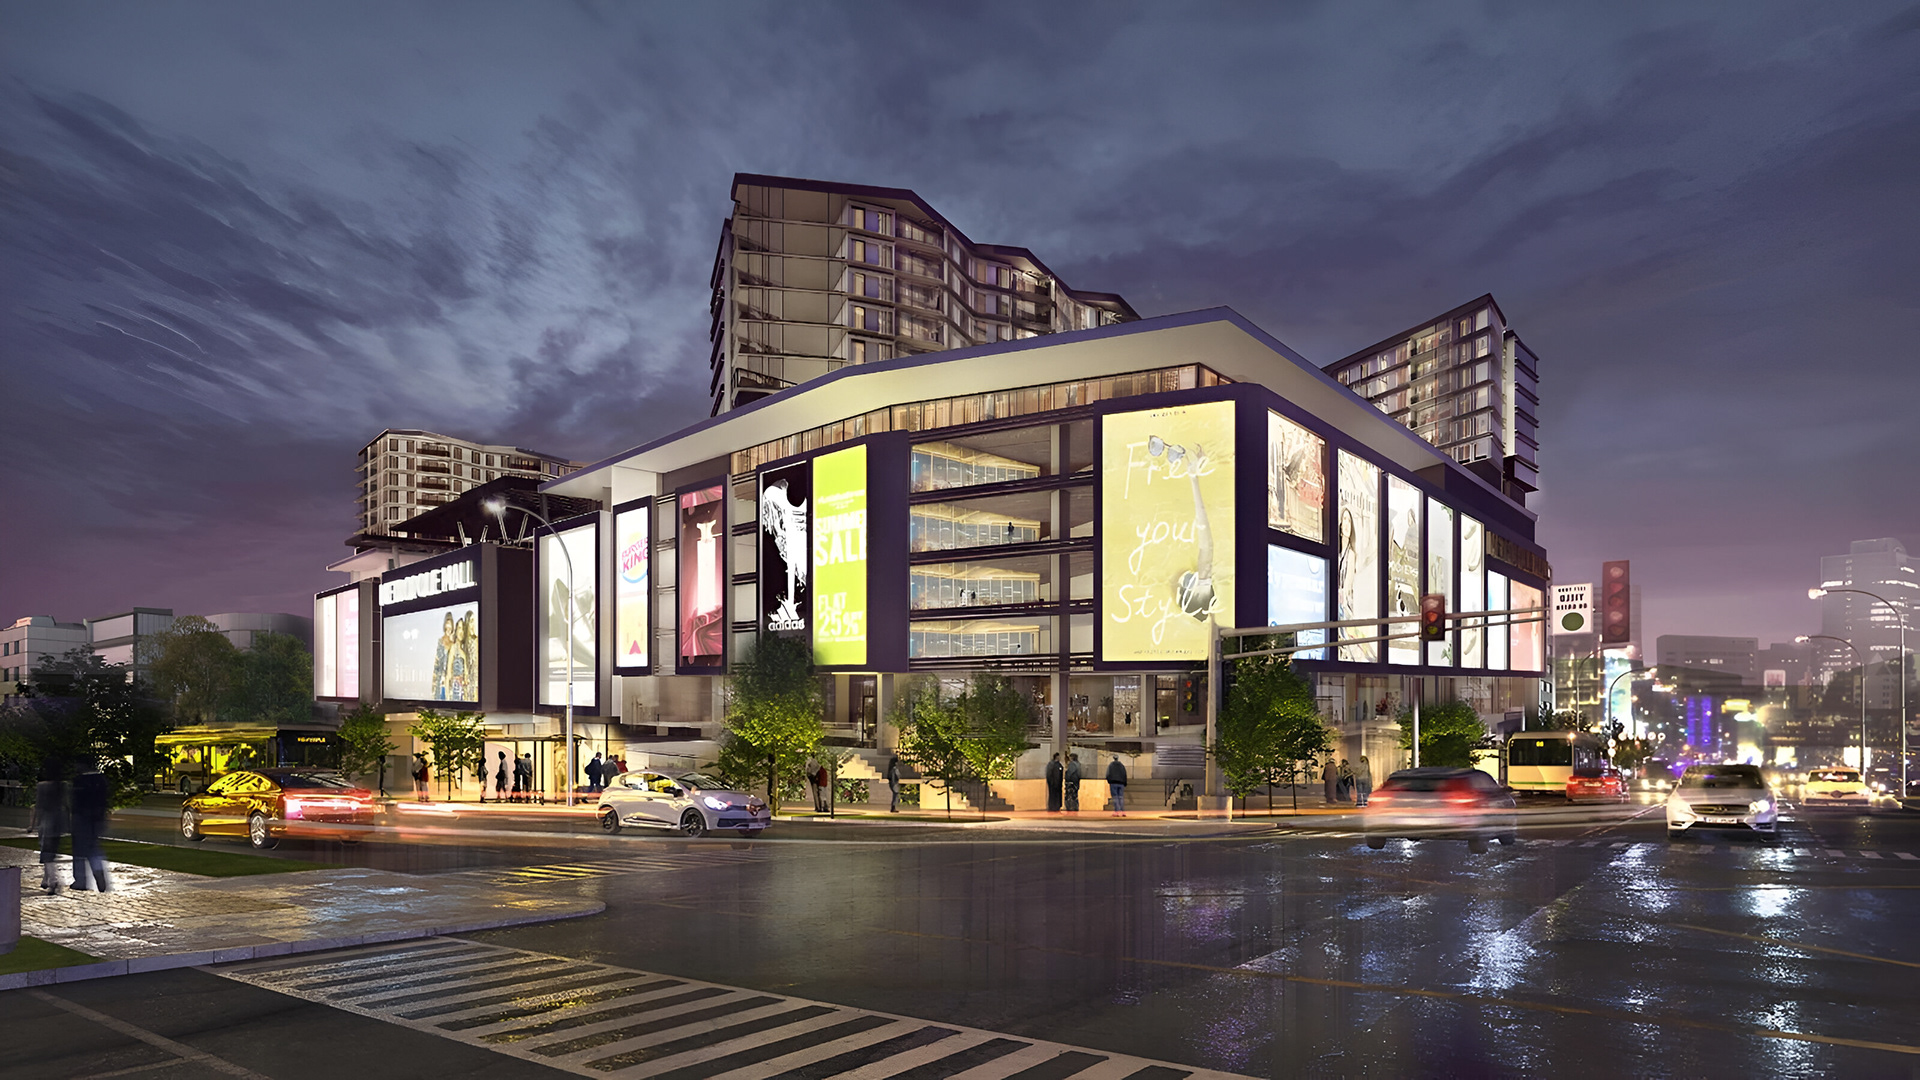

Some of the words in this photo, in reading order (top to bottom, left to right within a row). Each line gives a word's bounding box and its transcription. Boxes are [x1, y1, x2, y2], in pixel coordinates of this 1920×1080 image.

[1124, 441, 1216, 499] Free
[1128, 521, 1206, 575] your
[1111, 571, 1225, 645] Style
